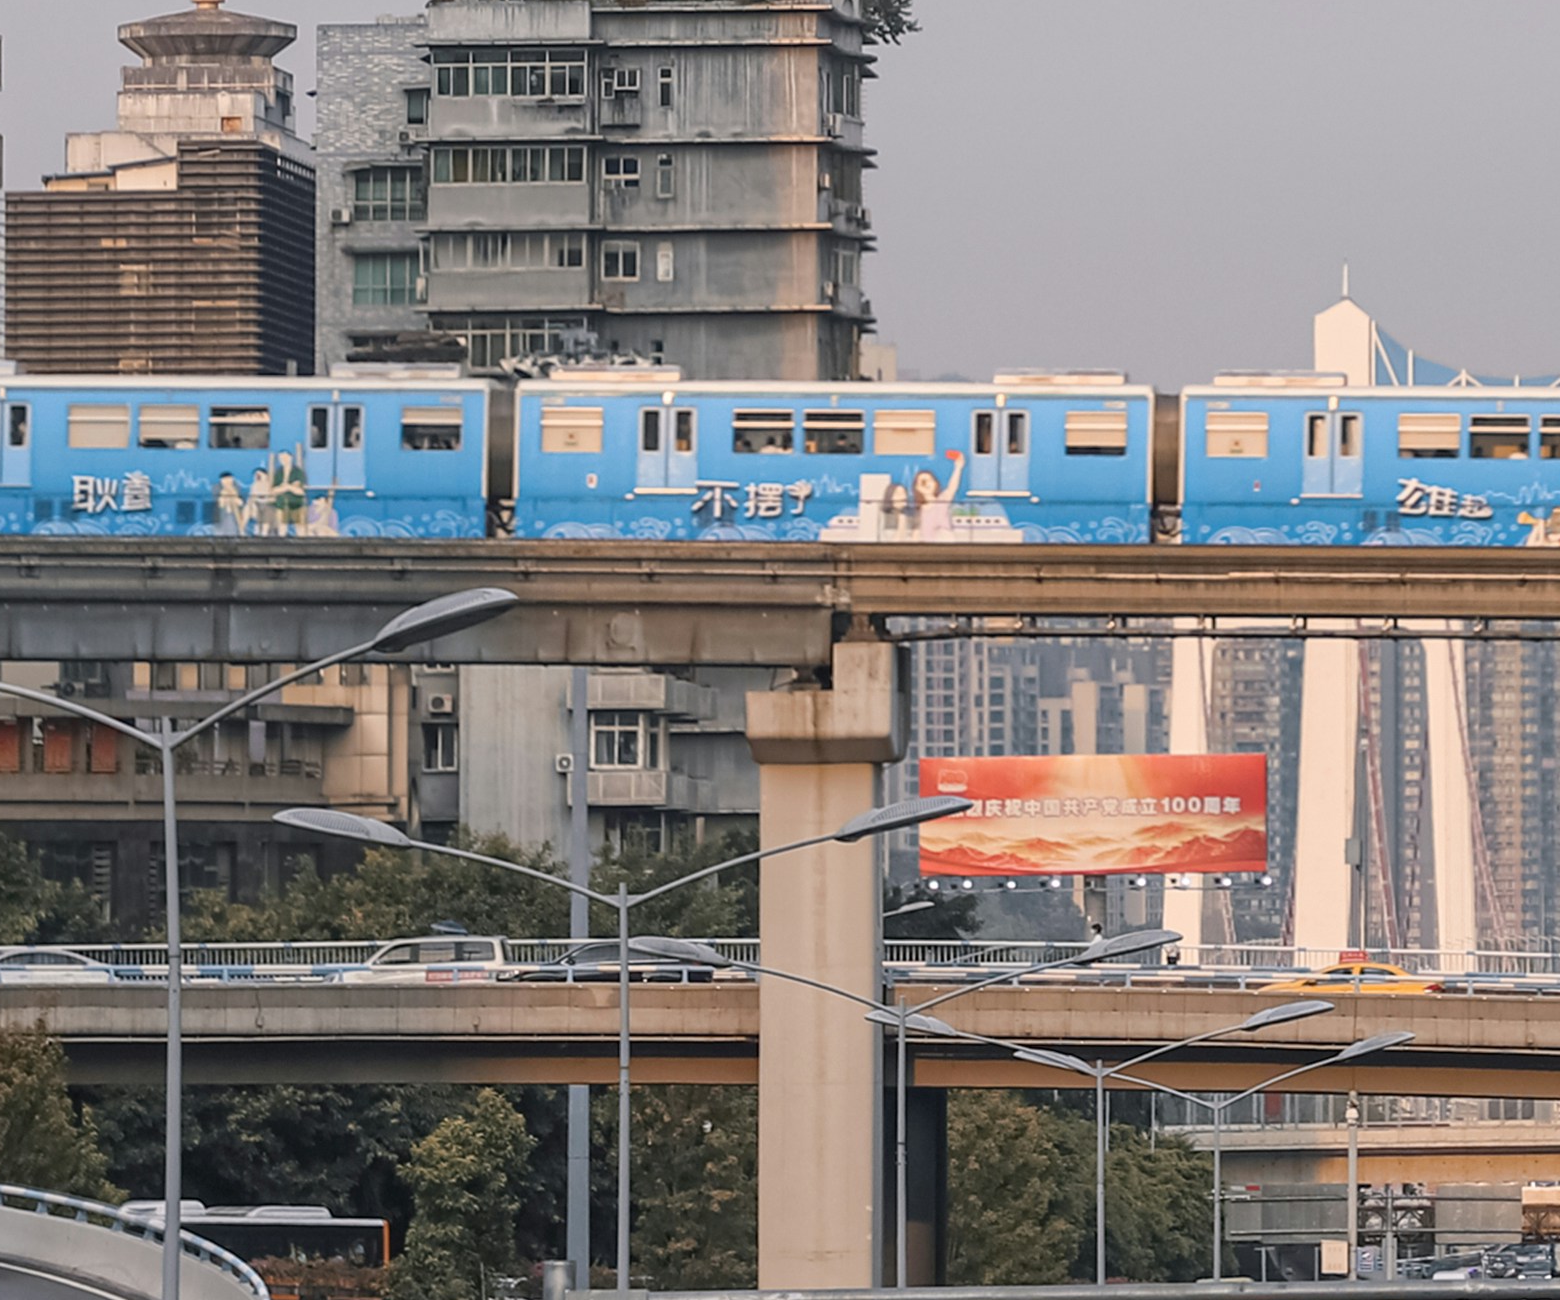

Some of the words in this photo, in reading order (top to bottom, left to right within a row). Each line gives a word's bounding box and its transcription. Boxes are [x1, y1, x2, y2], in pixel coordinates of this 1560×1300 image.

[691, 480, 814, 520] 不摆了
[1396, 478, 1493, 519] 雄起
